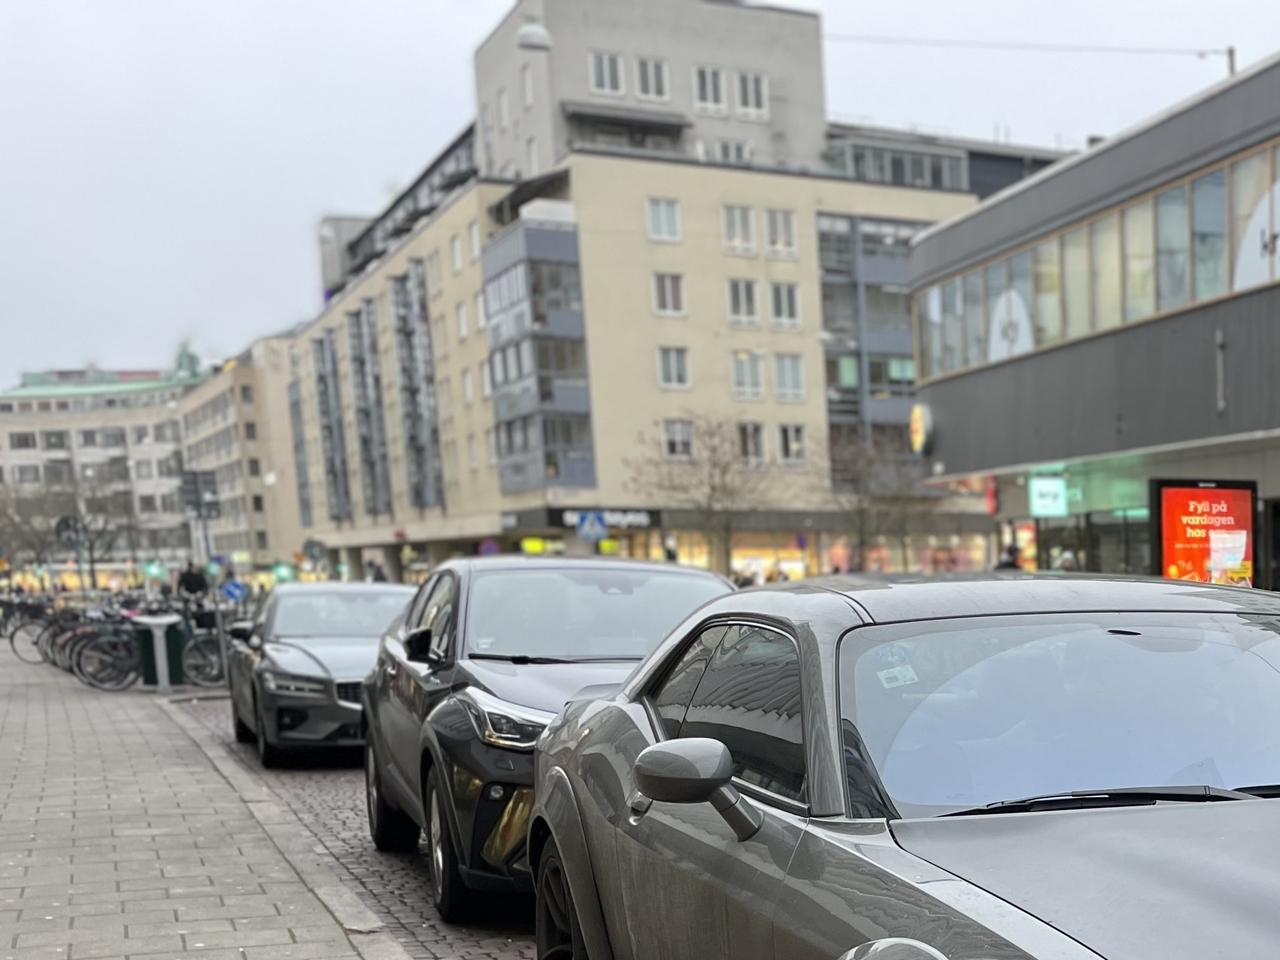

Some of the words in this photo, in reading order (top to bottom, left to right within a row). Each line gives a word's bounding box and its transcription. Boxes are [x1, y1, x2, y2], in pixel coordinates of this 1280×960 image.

[1188, 501, 1210, 514] Fyll
[1212, 500, 1228, 514] på
[1181, 515, 1235, 527] vardagen
[1186, 527, 1207, 538] hos
